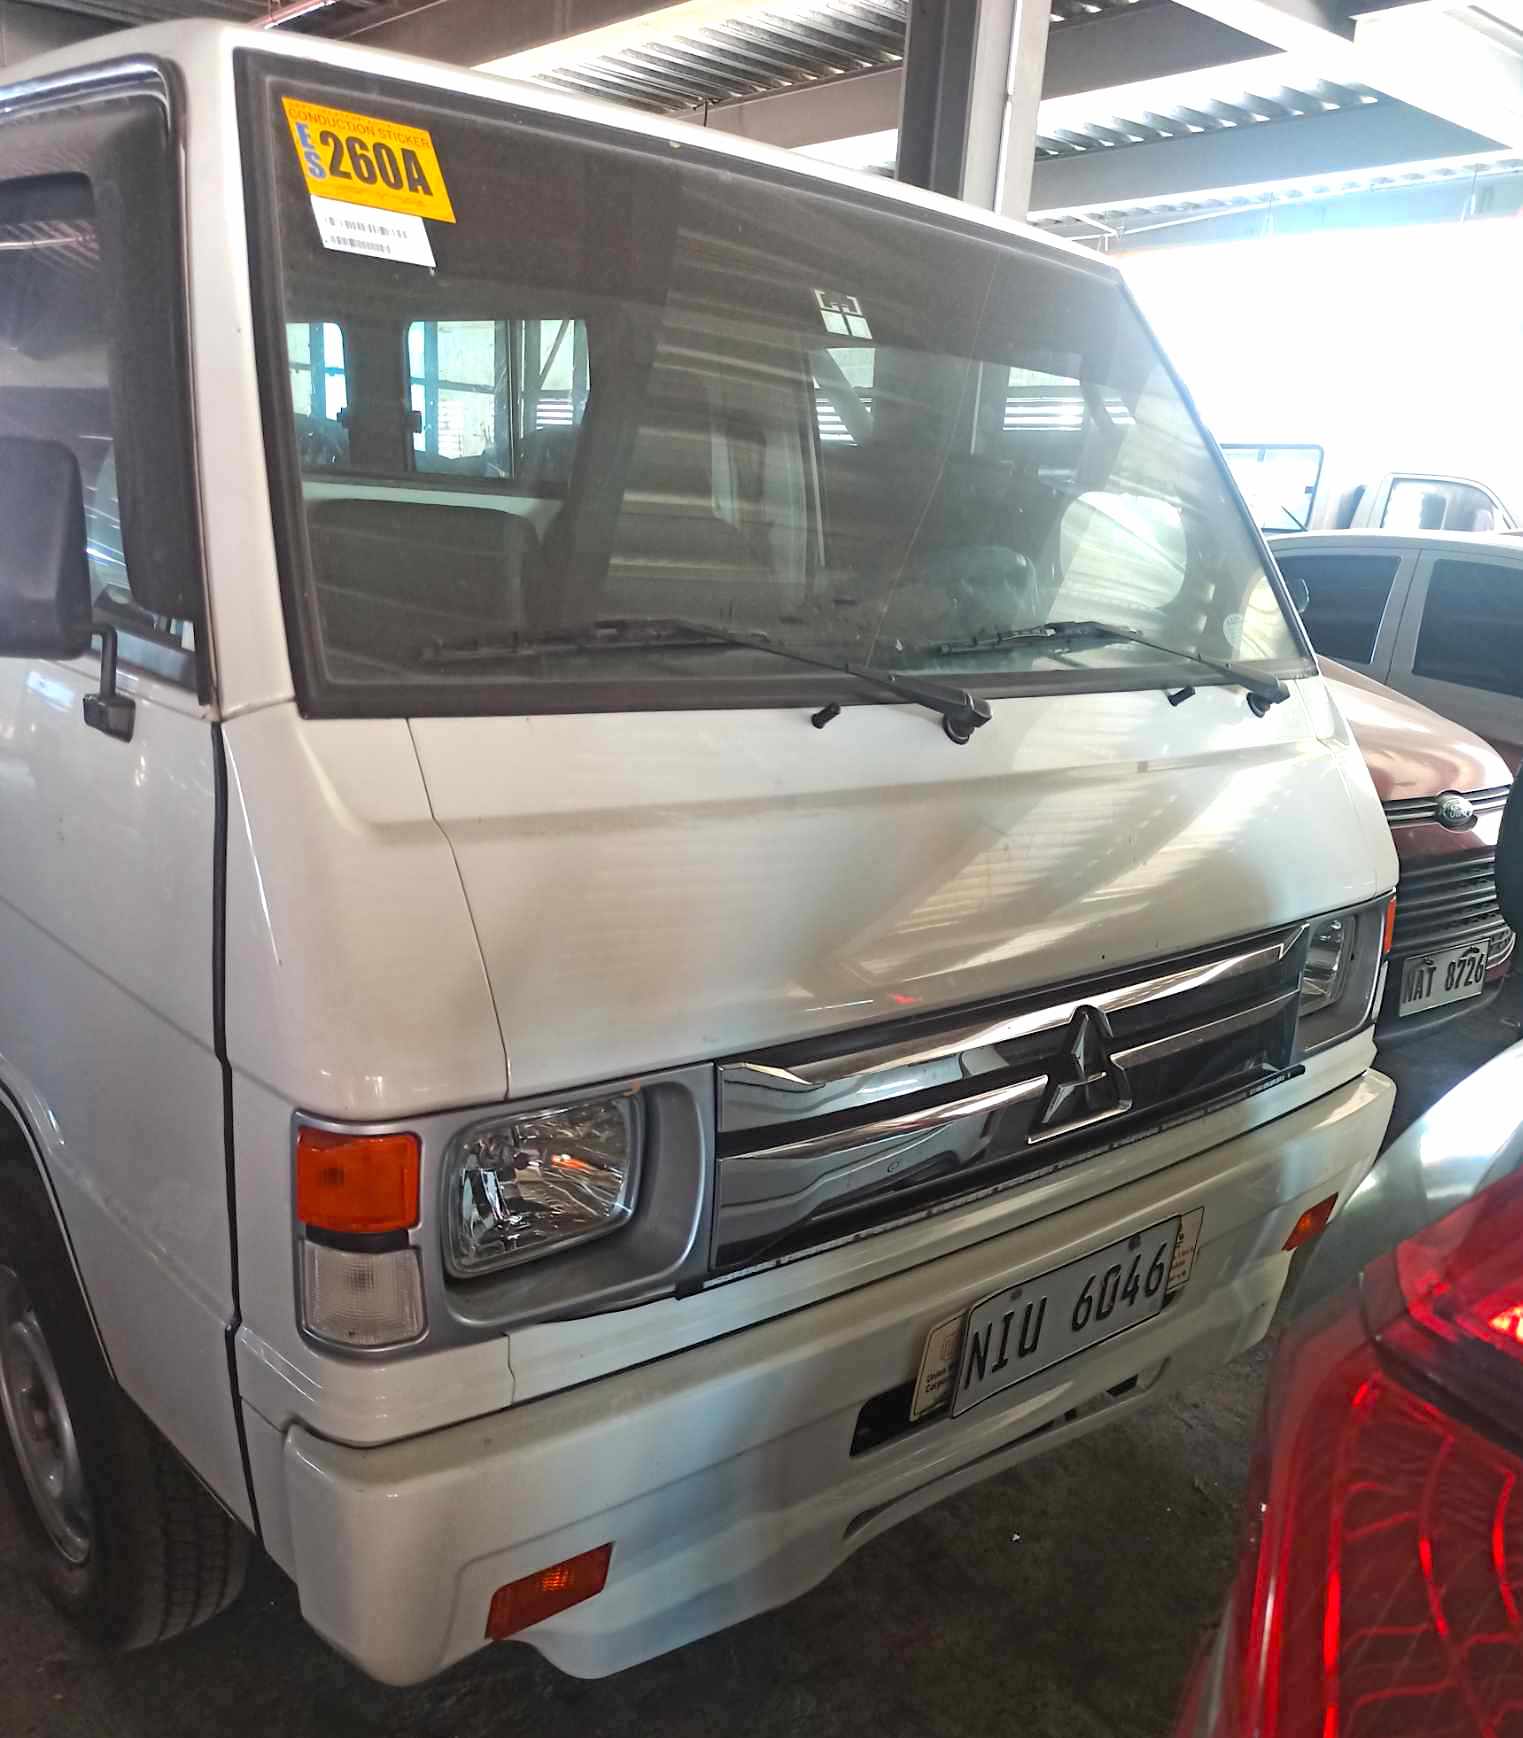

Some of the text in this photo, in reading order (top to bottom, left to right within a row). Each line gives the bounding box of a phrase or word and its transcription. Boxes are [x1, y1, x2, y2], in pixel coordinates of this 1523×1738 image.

[288, 107, 431, 149] CONDUCTION STICKER
[319, 129, 434, 197] 260A
[1444, 953, 1486, 993] 8726
[963, 1296, 1048, 1391] NIU
[1070, 1241, 1168, 1333] 6046
